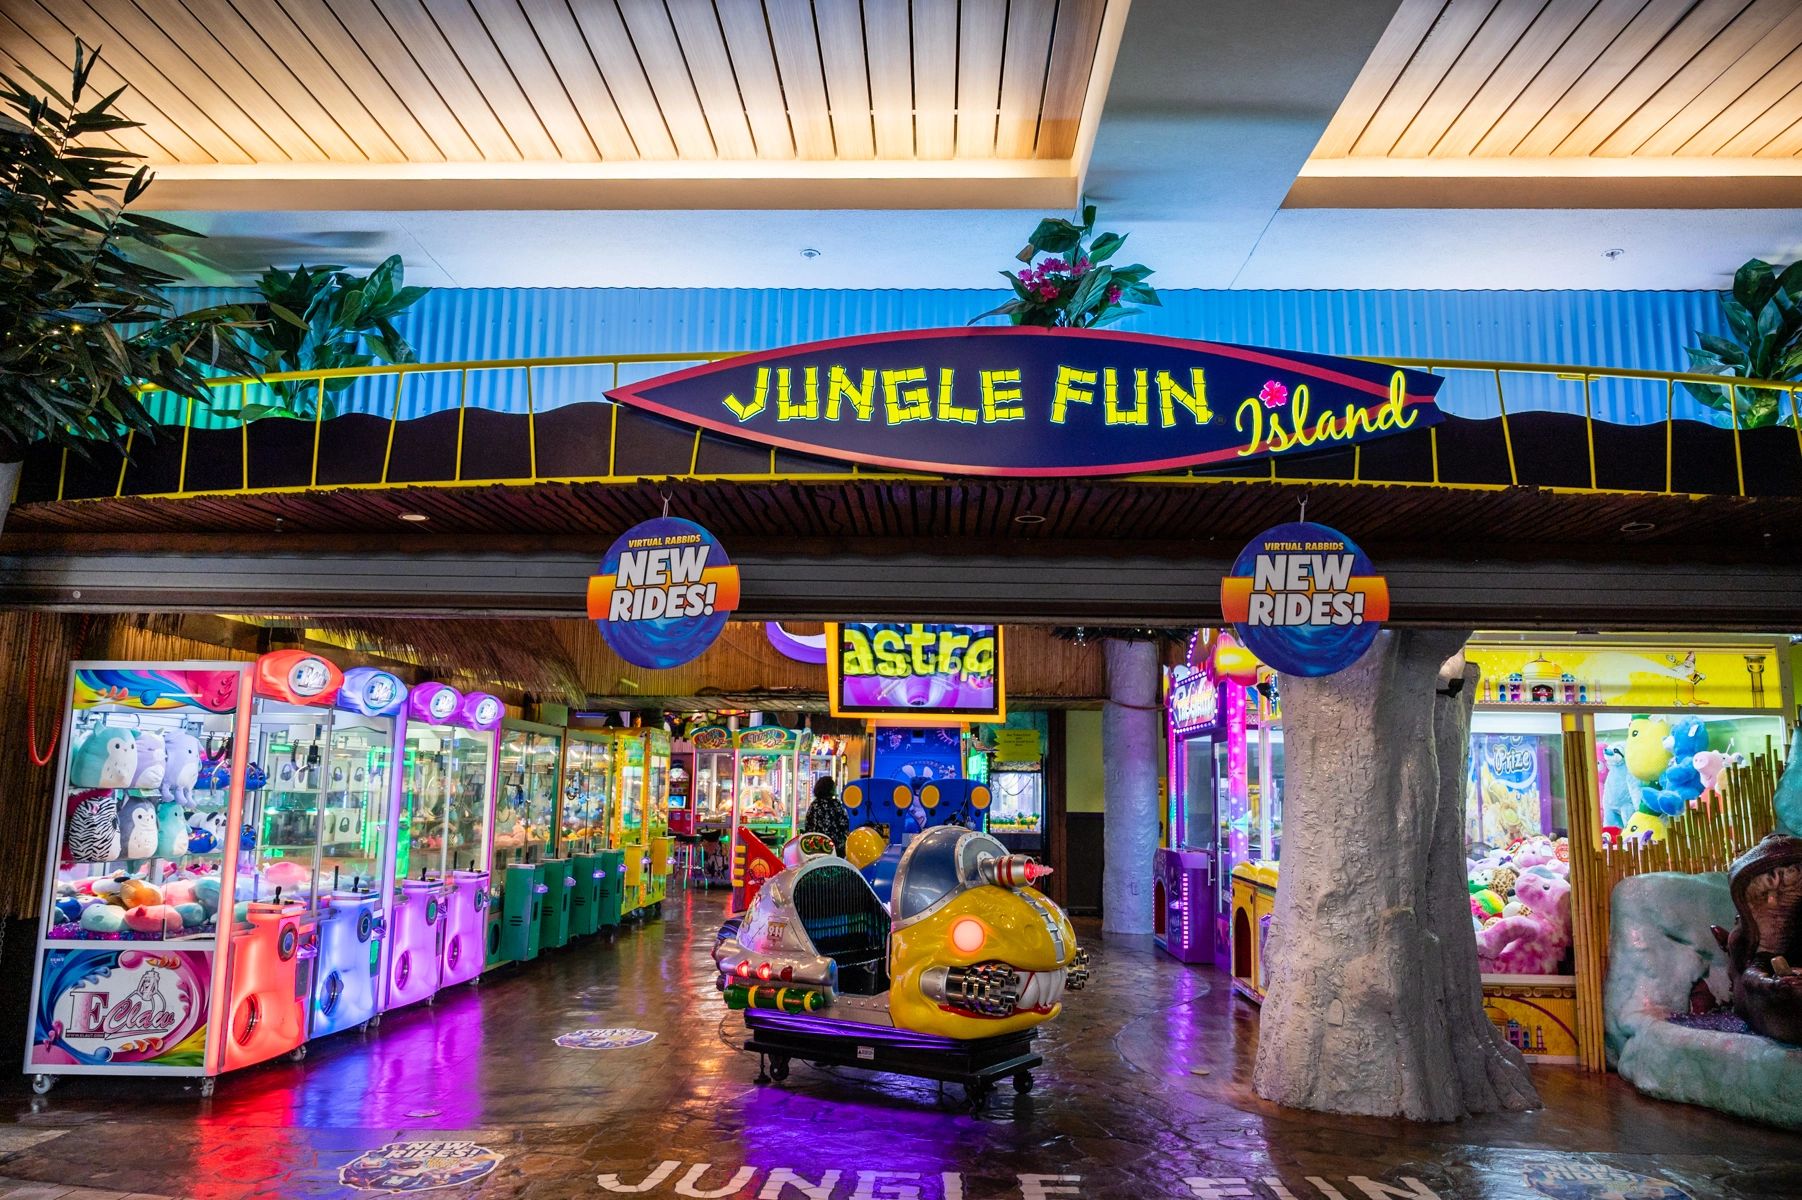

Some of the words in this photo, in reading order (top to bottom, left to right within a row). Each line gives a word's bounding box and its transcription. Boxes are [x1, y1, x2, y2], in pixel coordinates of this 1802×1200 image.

[722, 365, 1026, 426] JUNGLE
[1050, 364, 1214, 428] FUN
[1235, 369, 1419, 457] Island
[628, 537, 663, 548] VIRTUAL
[665, 534, 702, 545] RABBIDS
[1264, 542, 1303, 551] VIRTUAL
[1305, 542, 1344, 551] RABBIDS
[616, 545, 711, 588] NEW
[1253, 554, 1355, 591] NEW
[608, 582, 718, 622] RIDES!
[1248, 592, 1365, 627] RIDES!
[1493, 744, 1531, 775] Prize
